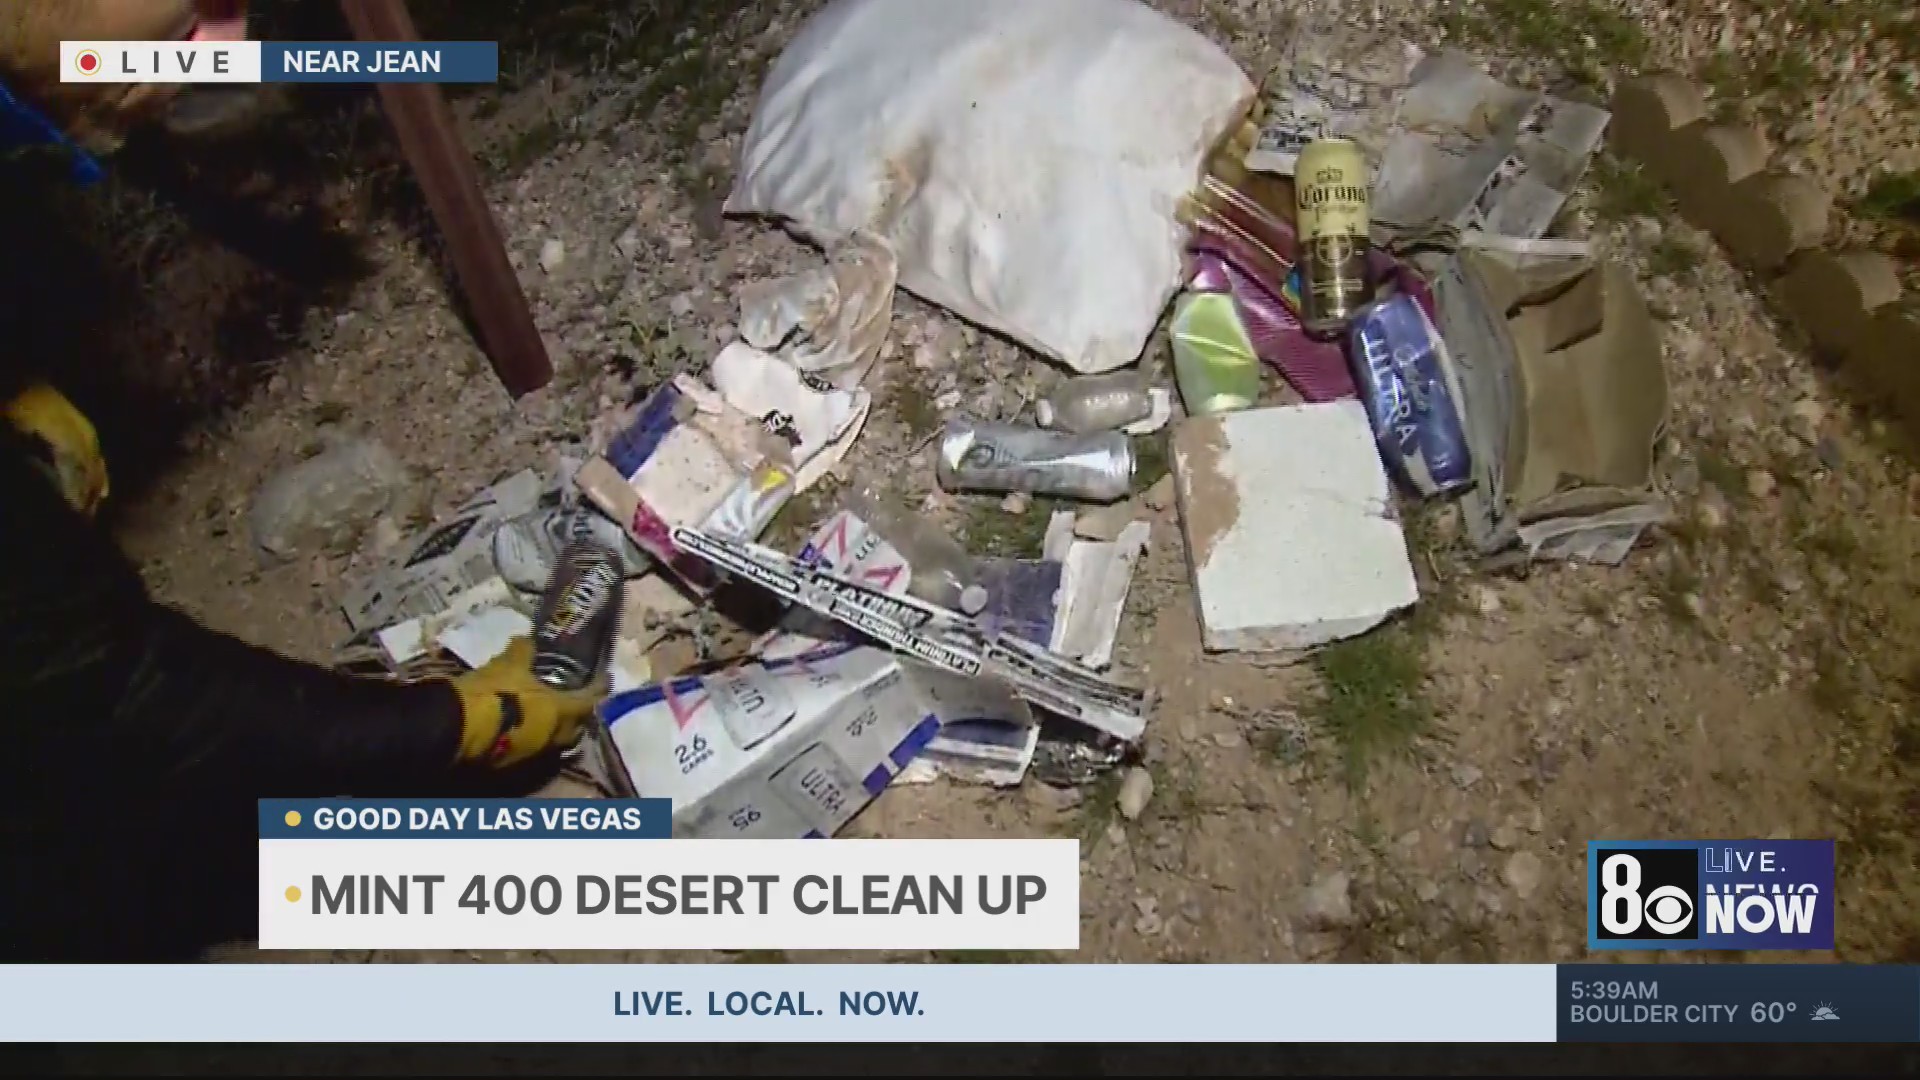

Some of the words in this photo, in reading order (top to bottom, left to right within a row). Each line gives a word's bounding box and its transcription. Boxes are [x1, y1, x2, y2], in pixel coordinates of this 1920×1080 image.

[1299, 184, 1366, 211] Corona
[673, 733, 708, 766] 2.6
[799, 768, 848, 815] ULTRA
